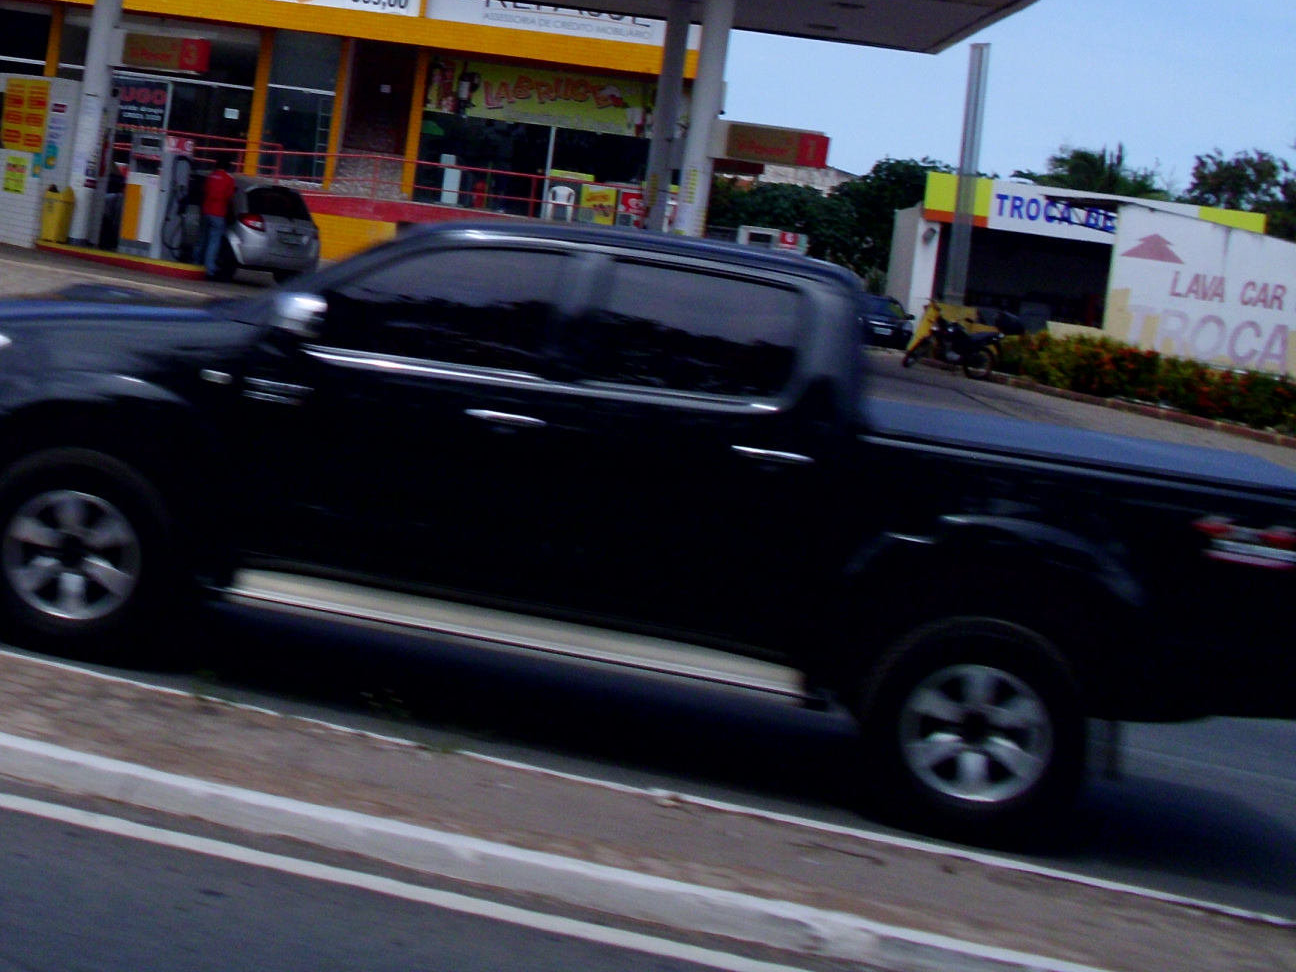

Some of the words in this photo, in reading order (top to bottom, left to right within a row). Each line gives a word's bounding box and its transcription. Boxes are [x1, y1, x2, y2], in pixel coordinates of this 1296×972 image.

[538, 17, 551, 29] DE
[995, 193, 1072, 226] TROCA
[1169, 270, 1226, 303] LAVA
[1239, 280, 1288, 311] CAR
[1127, 304, 1291, 376] TROCA
